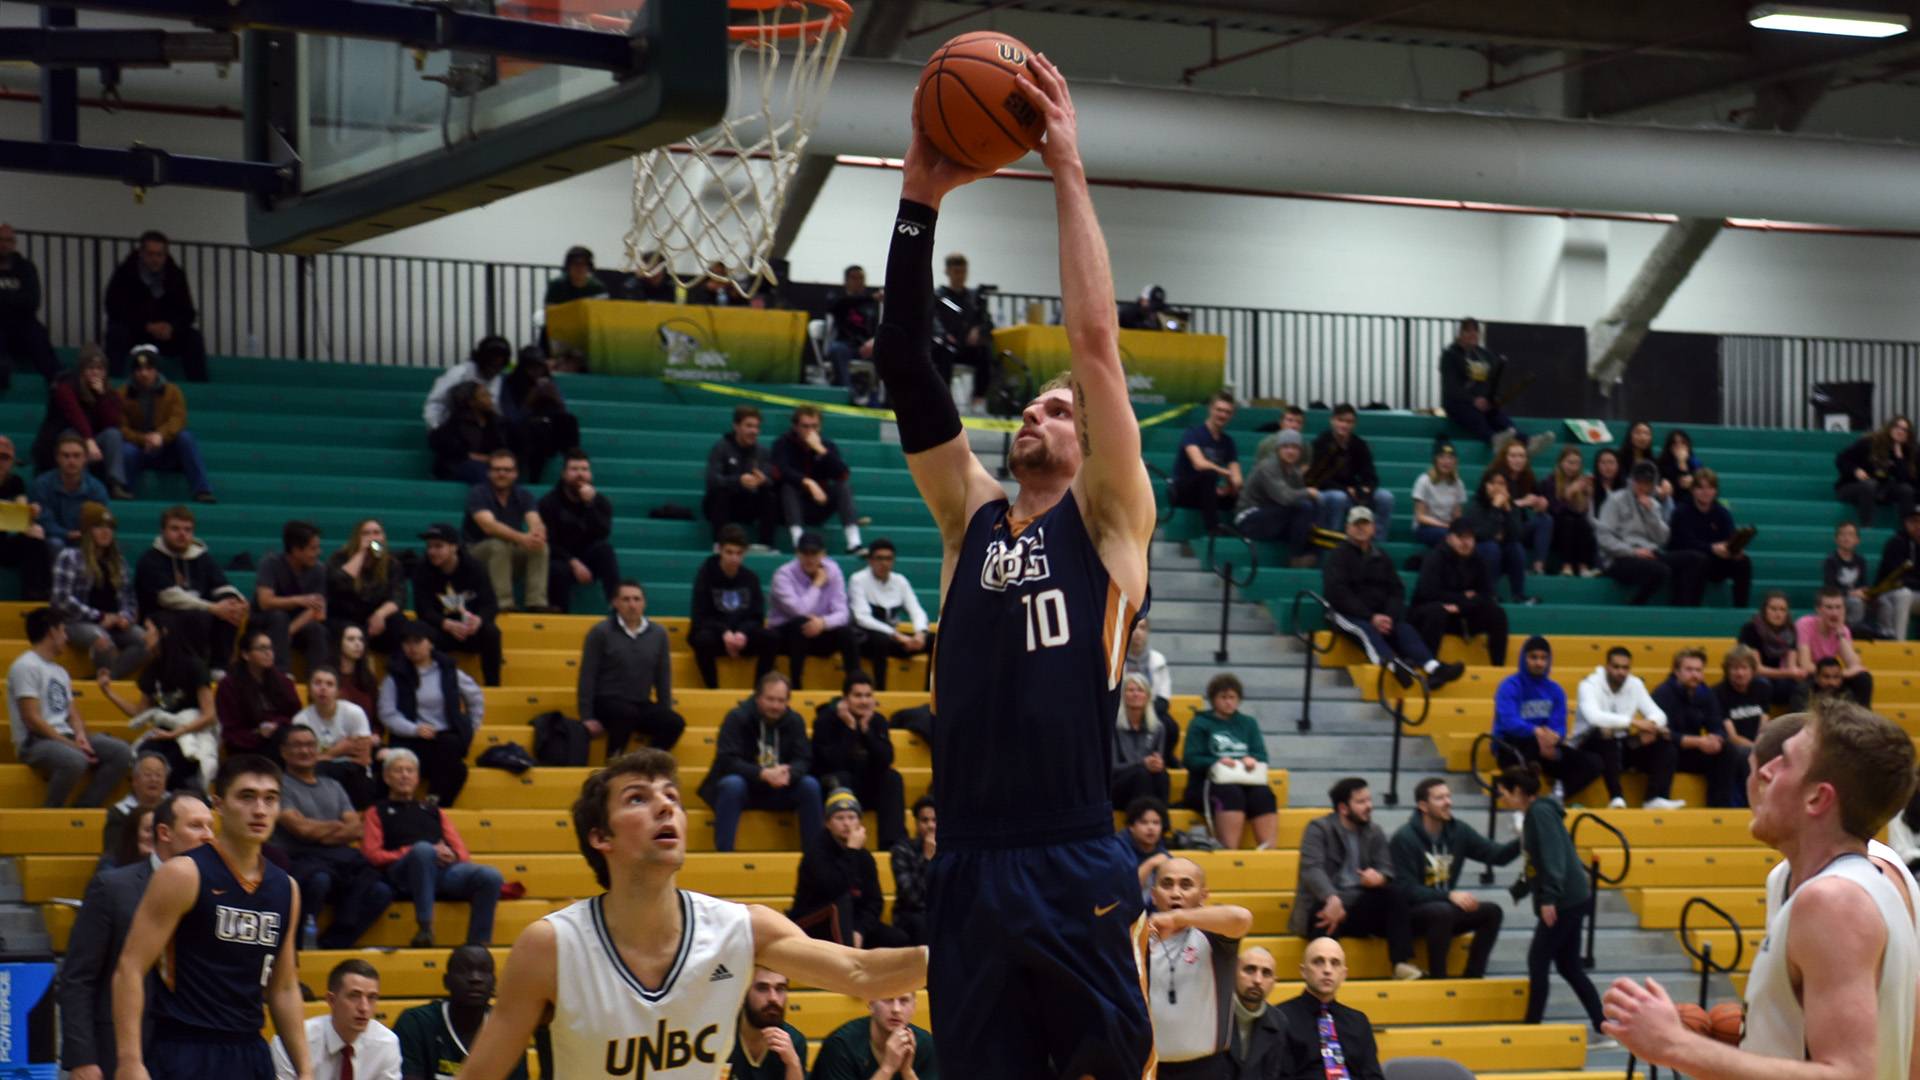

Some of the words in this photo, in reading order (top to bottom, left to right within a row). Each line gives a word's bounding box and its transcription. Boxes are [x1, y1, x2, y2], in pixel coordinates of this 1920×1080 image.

[1022, 588, 1070, 652] 10
[215, 904, 281, 948] UBC
[605, 1018, 719, 1080] UNBC
